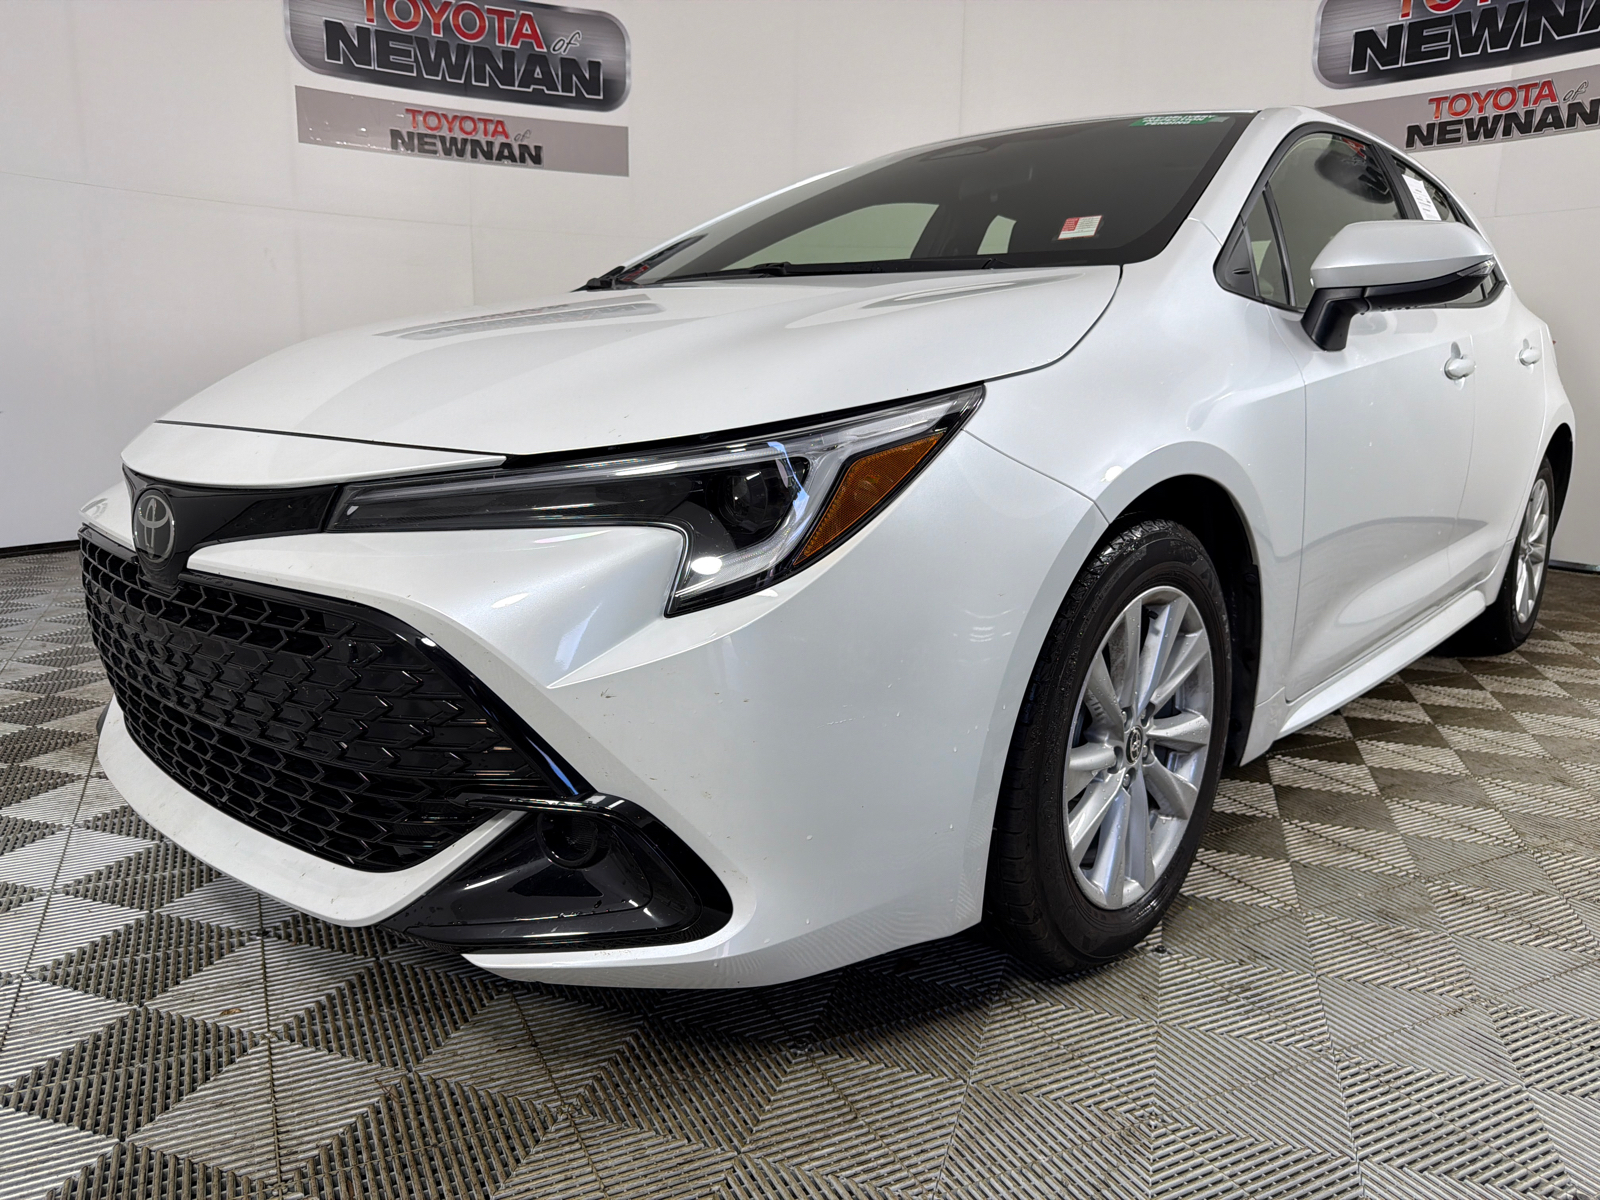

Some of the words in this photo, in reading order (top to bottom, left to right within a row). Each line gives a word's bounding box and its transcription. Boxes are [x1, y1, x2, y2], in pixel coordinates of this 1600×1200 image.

[364, 0, 547, 51] TOYOTA
[550, 31, 582, 54] of
[323, 19, 603, 99] NEWNAN
[1428, 79, 1558, 119] TOYOTA
[1562, 80, 1588, 102] of
[405, 108, 510, 139] TOYOTA
[514, 129, 532, 142] of
[1404, 98, 1599, 149] NEWNAN
[389, 129, 543, 165] NEWNAN
